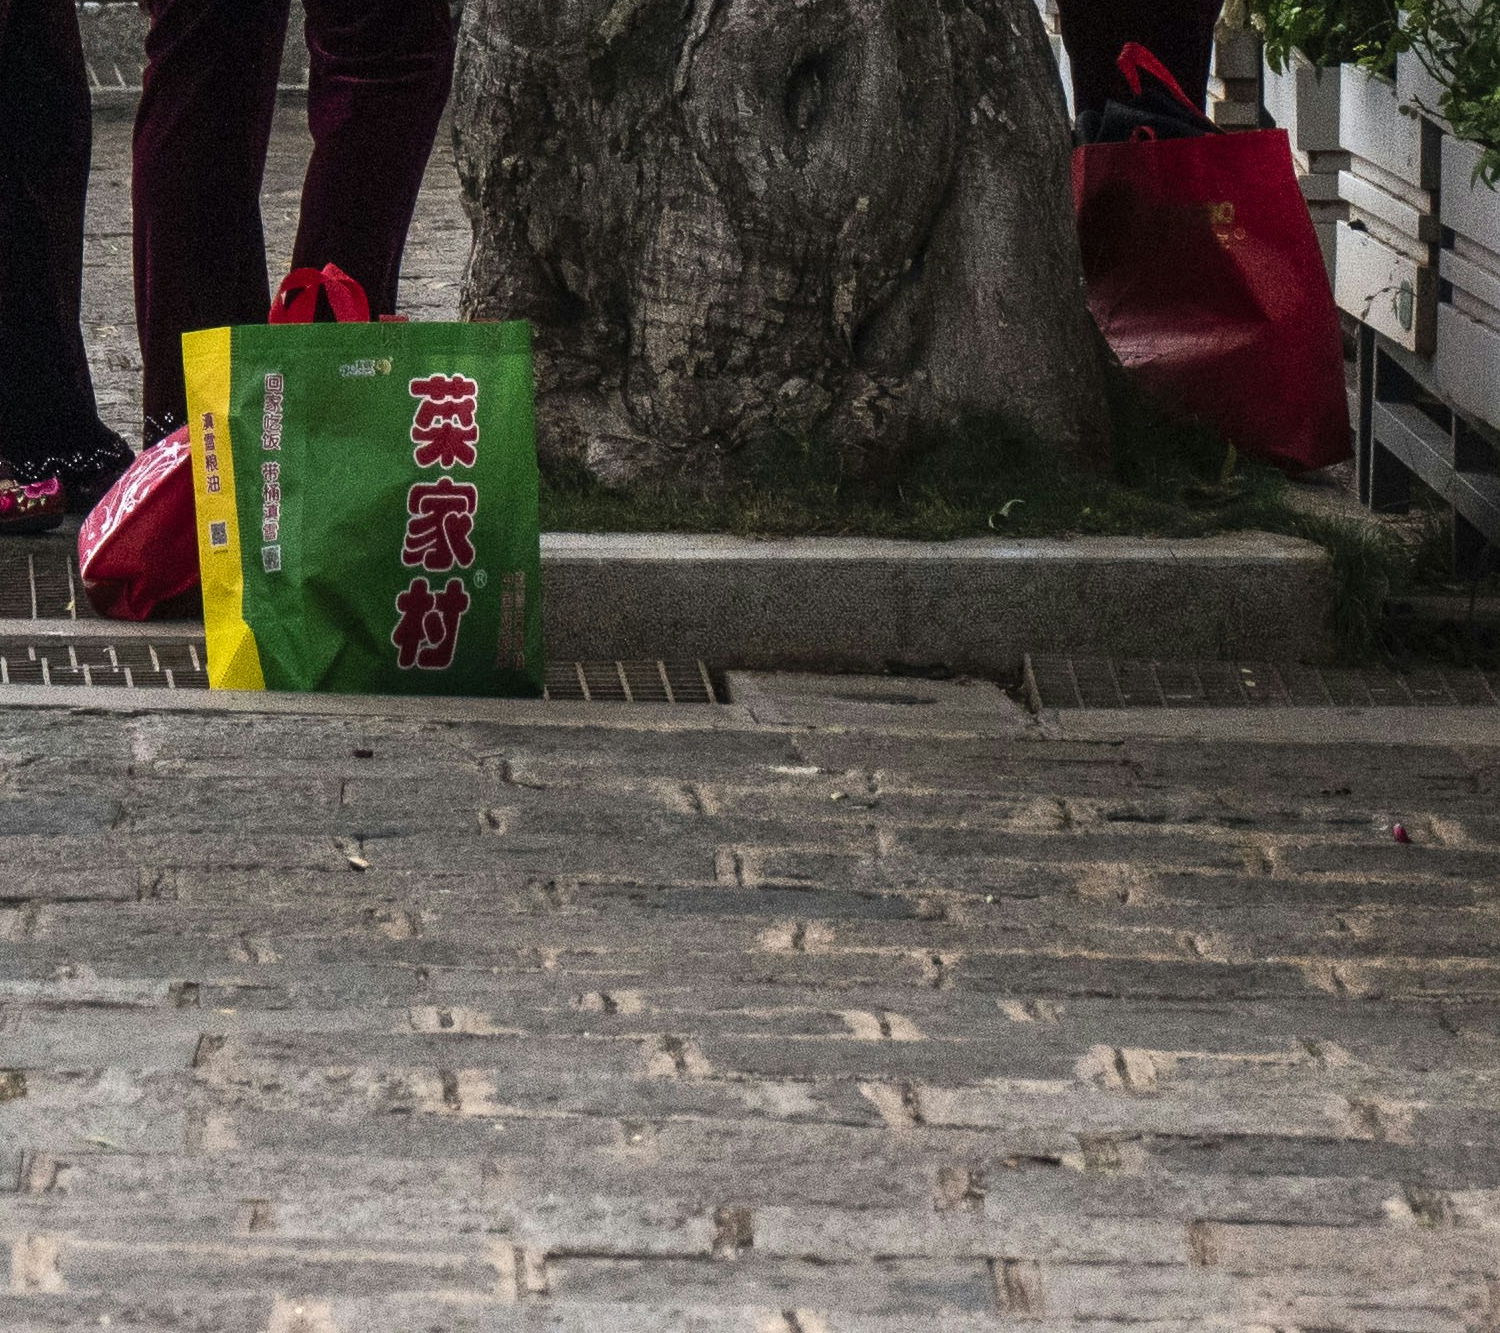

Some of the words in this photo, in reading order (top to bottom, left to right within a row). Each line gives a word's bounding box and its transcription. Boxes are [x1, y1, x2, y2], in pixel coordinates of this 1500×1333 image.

[262, 373, 284, 450] 回家吃饭
[202, 412, 221, 494] 滇雪粮油
[261, 461, 281, 541] 带桶滇雪
